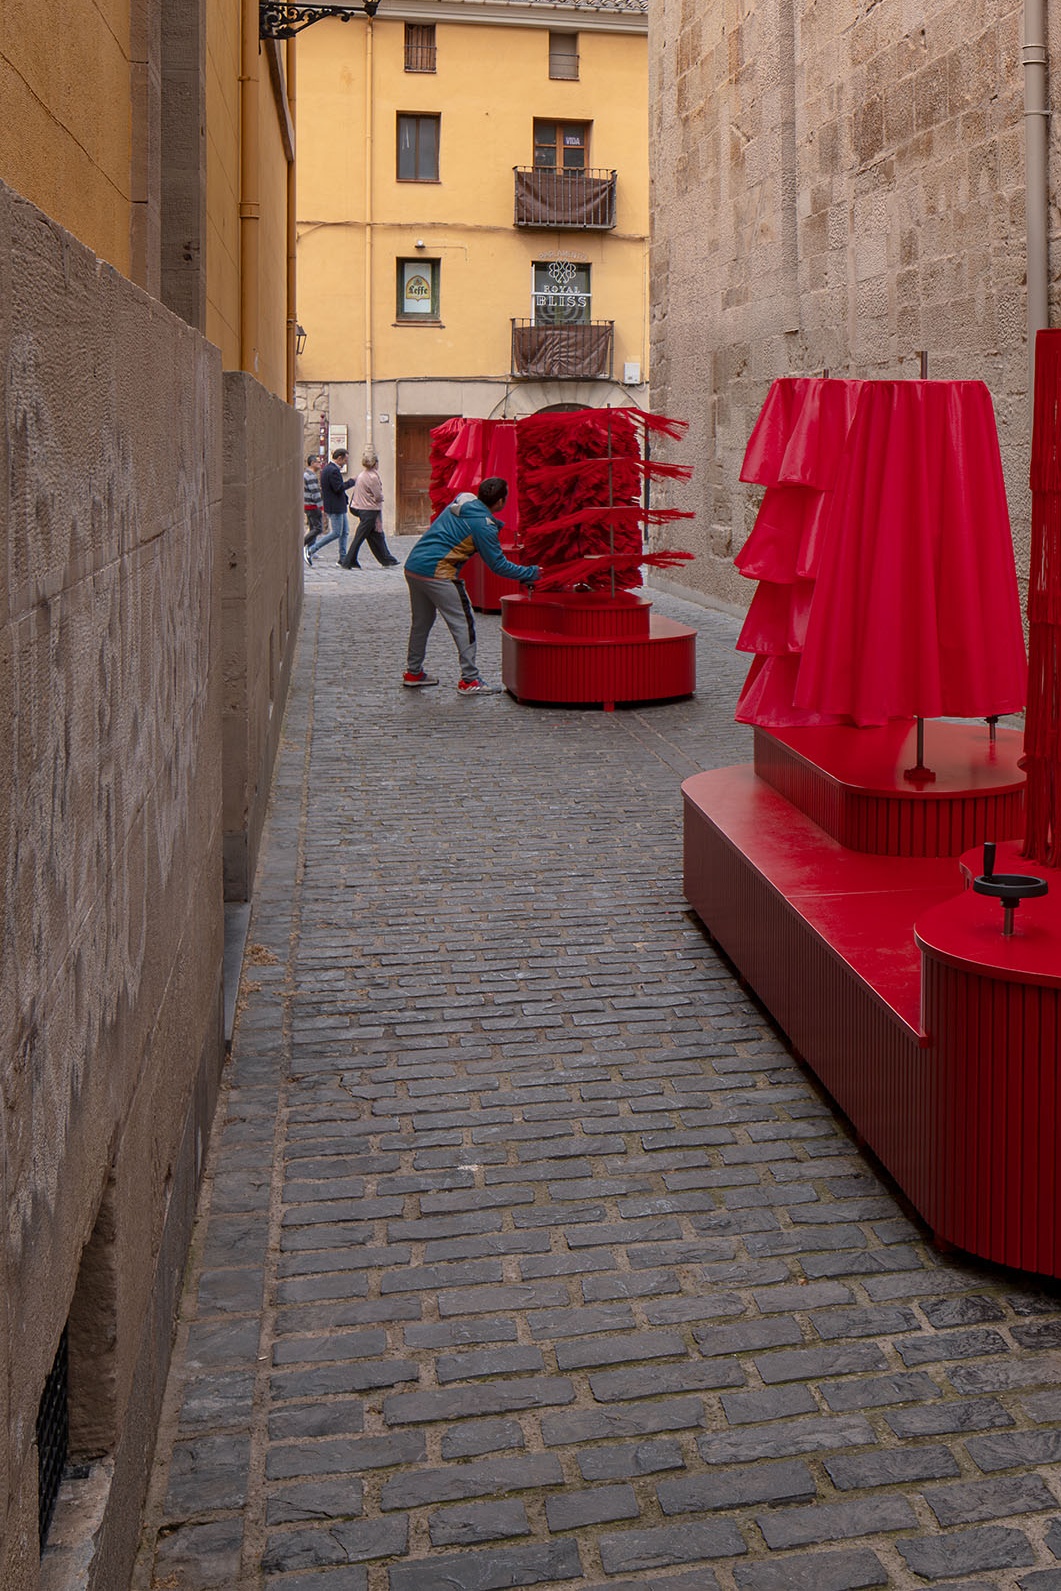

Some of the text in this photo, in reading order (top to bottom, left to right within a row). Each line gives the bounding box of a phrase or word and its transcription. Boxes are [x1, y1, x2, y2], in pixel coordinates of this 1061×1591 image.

[408, 285, 428, 295] Leffe
[544, 285, 580, 293] ROYAL
[536, 296, 587, 307] BLISS
